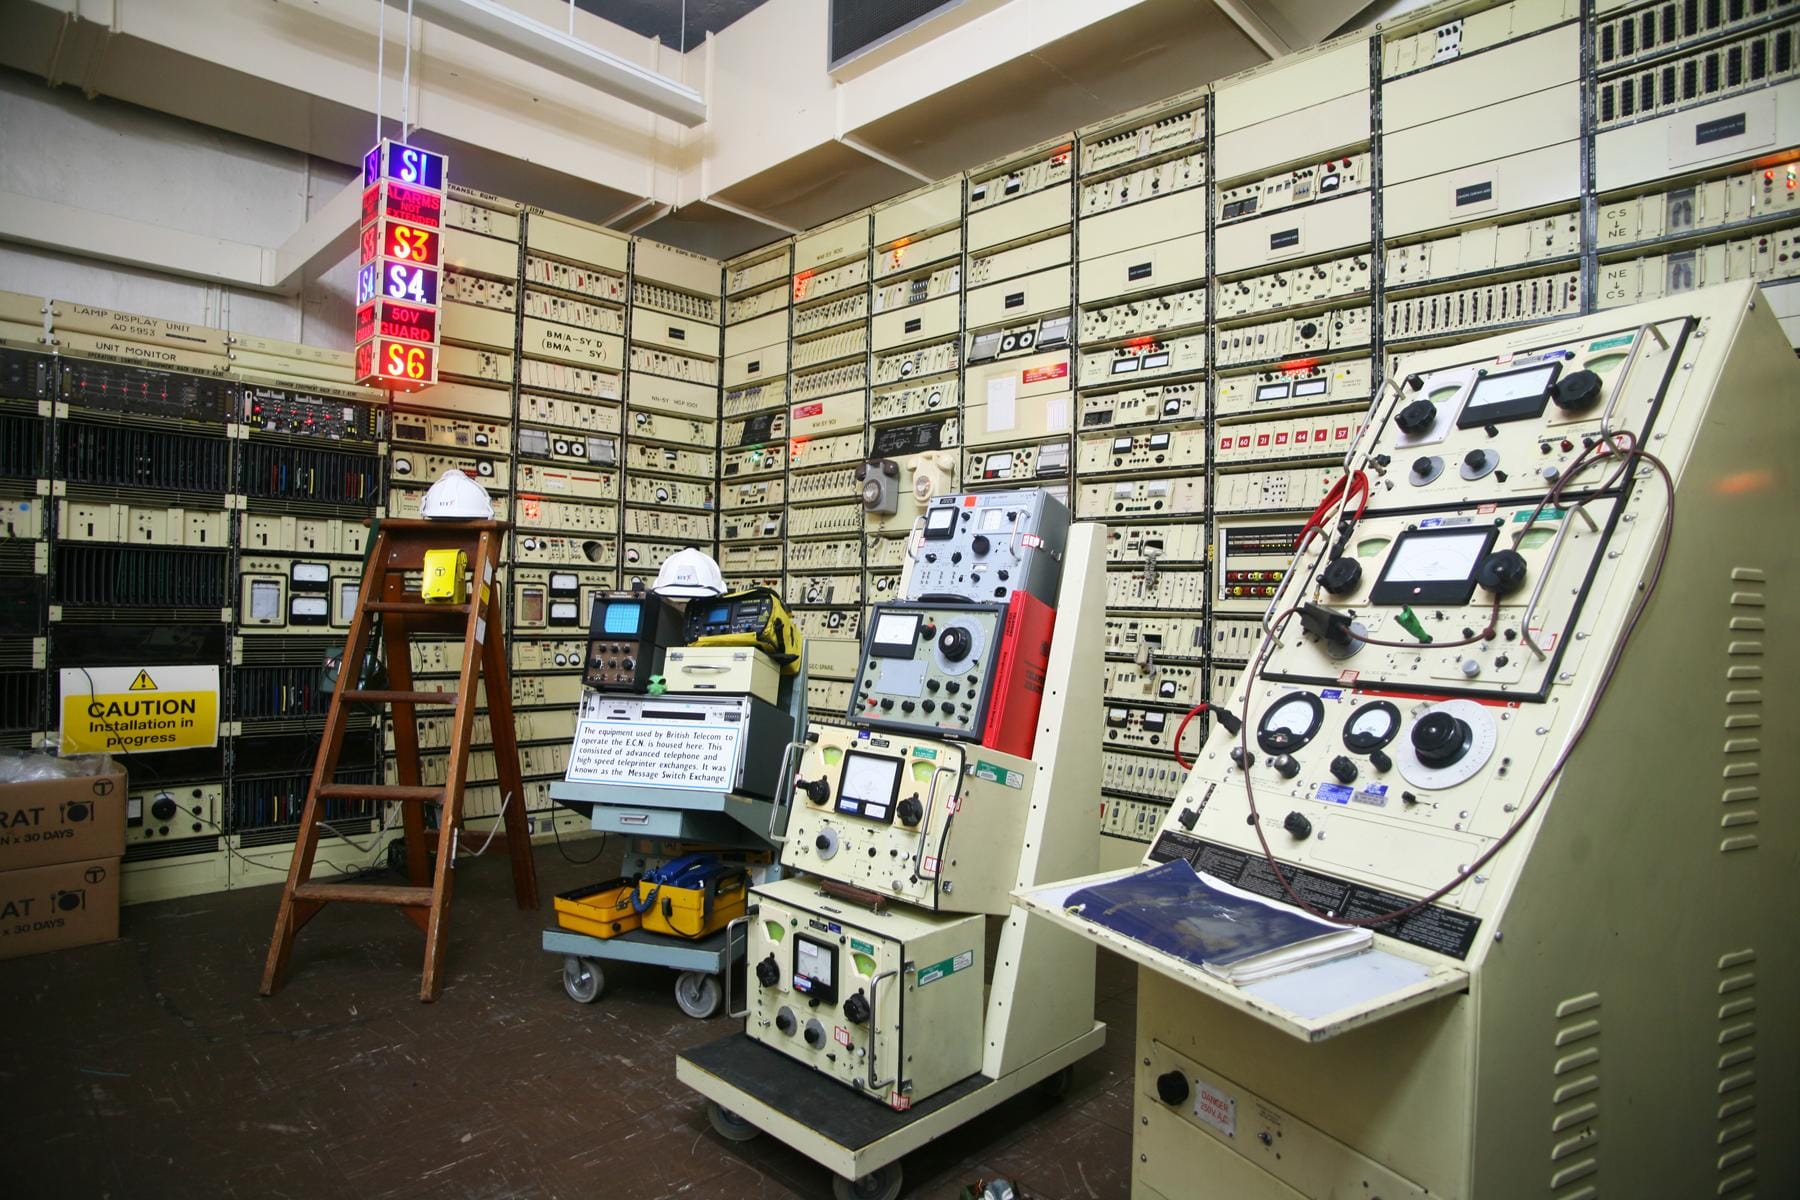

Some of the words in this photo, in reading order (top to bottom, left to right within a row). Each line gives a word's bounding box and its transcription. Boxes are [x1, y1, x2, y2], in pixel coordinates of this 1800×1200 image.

[401, 150, 427, 184] S1
[401, 202, 420, 214] NOT
[394, 226, 429, 262] S3
[73, 306, 108, 318] LAMP
[114, 313, 158, 327] DISPLAY
[166, 323, 190, 333] UNIT
[392, 308, 420, 324] 50V
[110, 323, 127, 332] AD
[380, 322, 431, 341] GUARD
[95, 341, 120, 353] UNIT
[125, 346, 177, 361] MONITOR
[388, 344, 425, 379] S6
[1240, 438, 1248, 446] 60
[1278, 434, 1286, 443] 38
[1338, 430, 1347, 438] 57
[87, 699, 195, 718] CAUTION
[89, 719, 176, 733] Installation
[181, 718, 193, 728] in
[106, 734, 176, 748] progress
[598, 728, 633, 737] equipment
[655, 731, 662, 739] by
[666, 731, 690, 739] British
[693, 732, 721, 741] Telecom
[579, 747, 612, 755] consisted
[626, 749, 660, 757] advanced
[664, 751, 700, 760] telephone
[656, 741, 683, 749] housed
[686, 742, 704, 750] here.
[708, 743, 722, 751] This
[577, 756, 591, 765] high
[594, 758, 614, 766] speed
[617, 759, 656, 768] teleprinter
[660, 762, 699, 772] exchanges.
[575, 766, 598, 774] known
[628, 769, 659, 779] Message
[662, 771, 686, 780] Switch
[689, 773, 726, 784] Exchange.
[24, 833, 41, 843] 30
[43, 829, 75, 841] DAYS
[14, 924, 31, 934] 30
[33, 918, 65, 931] DAYS
[1201, 1090, 1229, 1112] DANGER
